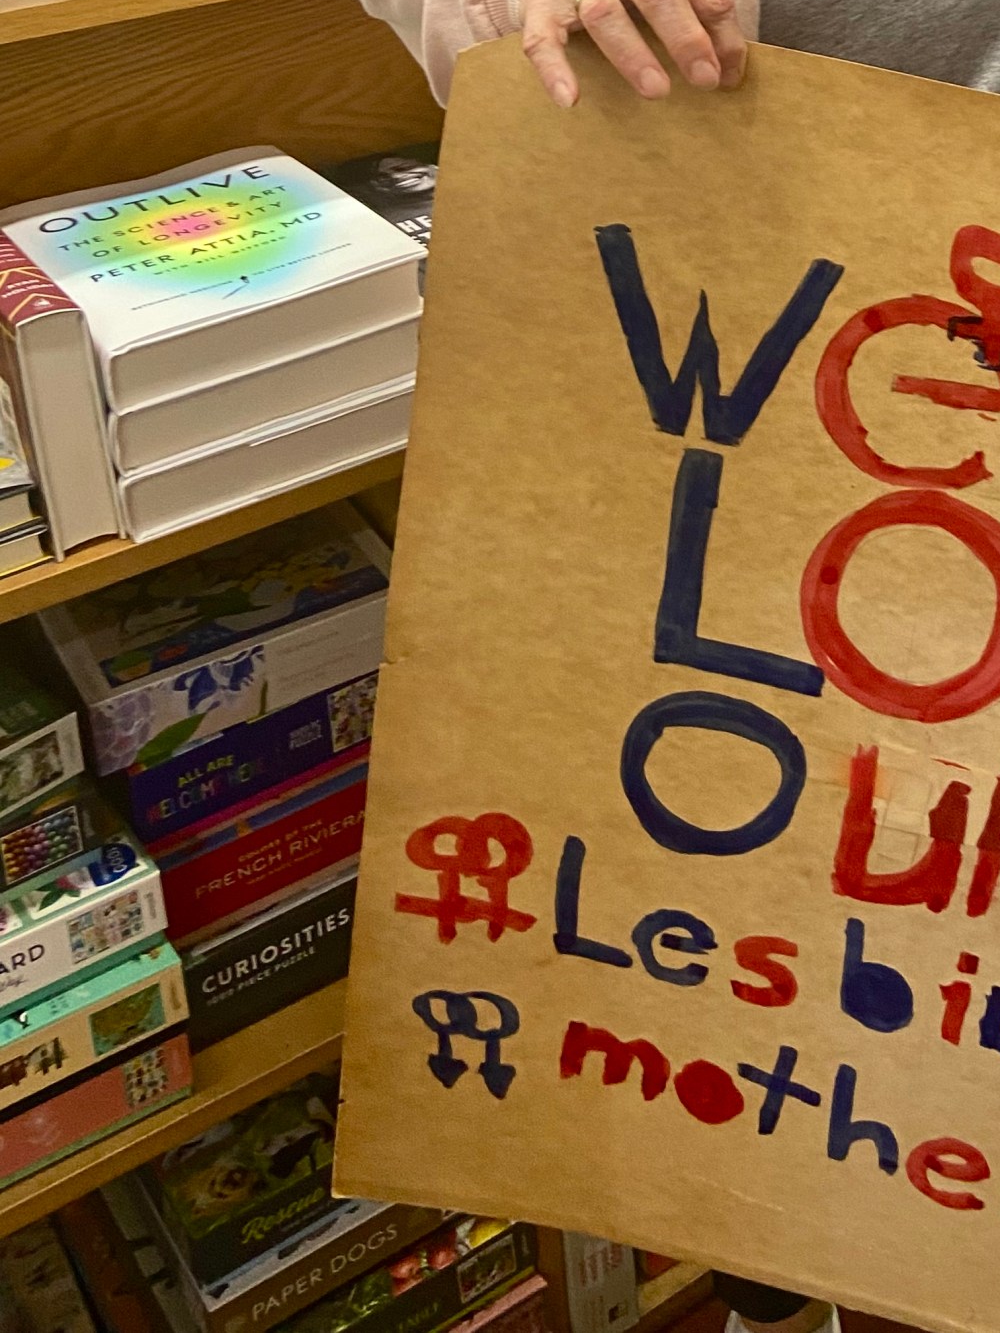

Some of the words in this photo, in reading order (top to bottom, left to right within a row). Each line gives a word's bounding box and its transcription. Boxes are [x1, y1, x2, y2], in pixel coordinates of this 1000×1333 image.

[39, 165, 270, 233] OUTLIVE
[57, 234, 104, 251] THE
[113, 205, 218, 237] SCIENCE
[226, 201, 240, 209] &
[248, 185, 288, 202] ART
[92, 245, 123, 258] OF
[139, 201, 284, 246] LONGEVITY
[90, 254, 175, 283] PETER
[280, 211, 322, 228] MD
[177, 767, 205, 788] ALL
[206, 754, 235, 772] ARE
[195, 850, 283, 899] FRENCH
[289, 810, 366, 854] RIVIERA
[202, 908, 350, 993] CURIOSITIES
[238, 969, 272, 989] PIECE
[274, 946, 316, 972] PUZZLE
[252, 1268, 323, 1321] PAPER
[329, 1223, 398, 1274] DOGS
